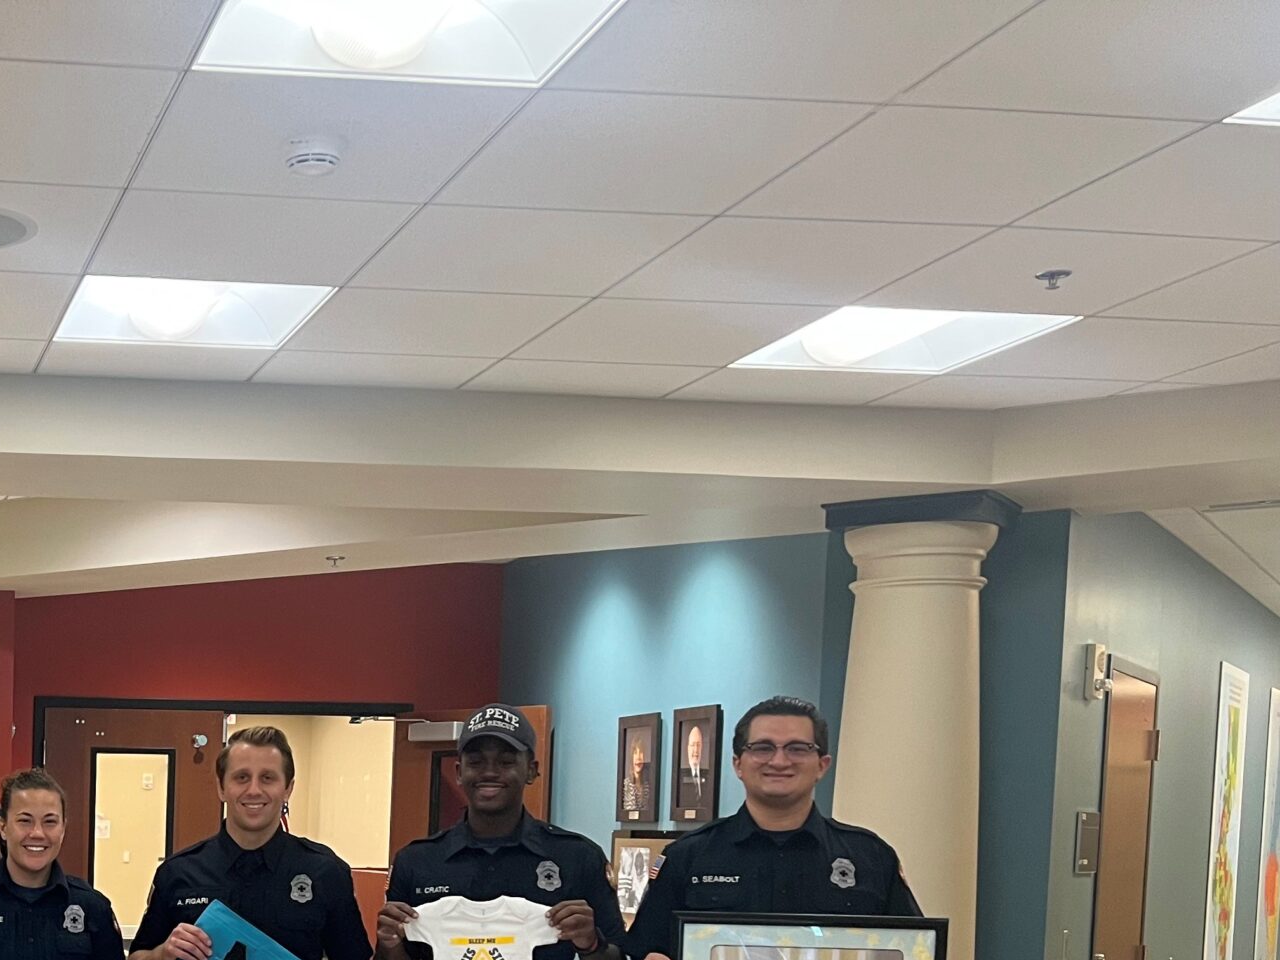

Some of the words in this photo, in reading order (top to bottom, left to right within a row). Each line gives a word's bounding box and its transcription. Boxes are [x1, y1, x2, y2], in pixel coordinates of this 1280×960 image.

[468, 712, 482, 729] ST.
[485, 708, 519, 727] PETE
[692, 876, 700, 884] D.
[424, 886, 449, 894] CRATIC
[185, 897, 209, 905] FIGARI
